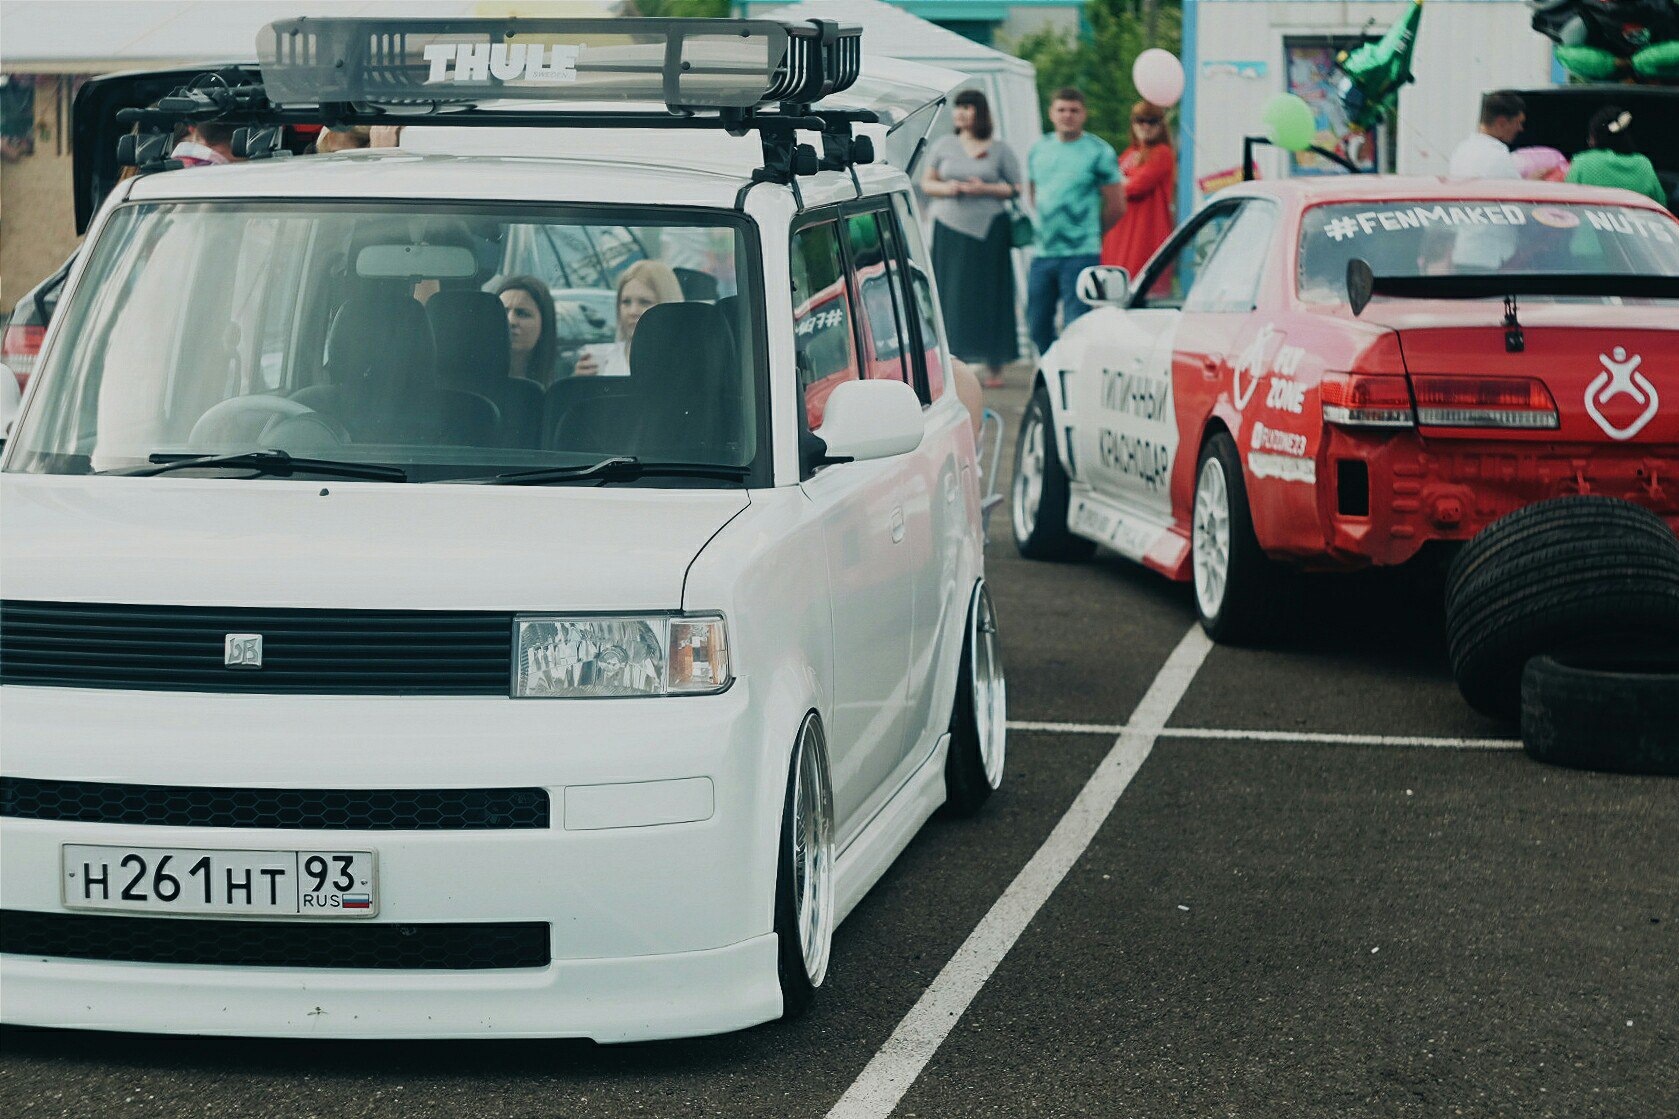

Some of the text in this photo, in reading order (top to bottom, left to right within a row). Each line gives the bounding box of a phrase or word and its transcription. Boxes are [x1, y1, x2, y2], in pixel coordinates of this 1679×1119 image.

[423, 43, 580, 81] THULE
[533, 71, 572, 79] SWEDEN
[304, 855, 355, 893] 93
[303, 893, 340, 908] RUS
